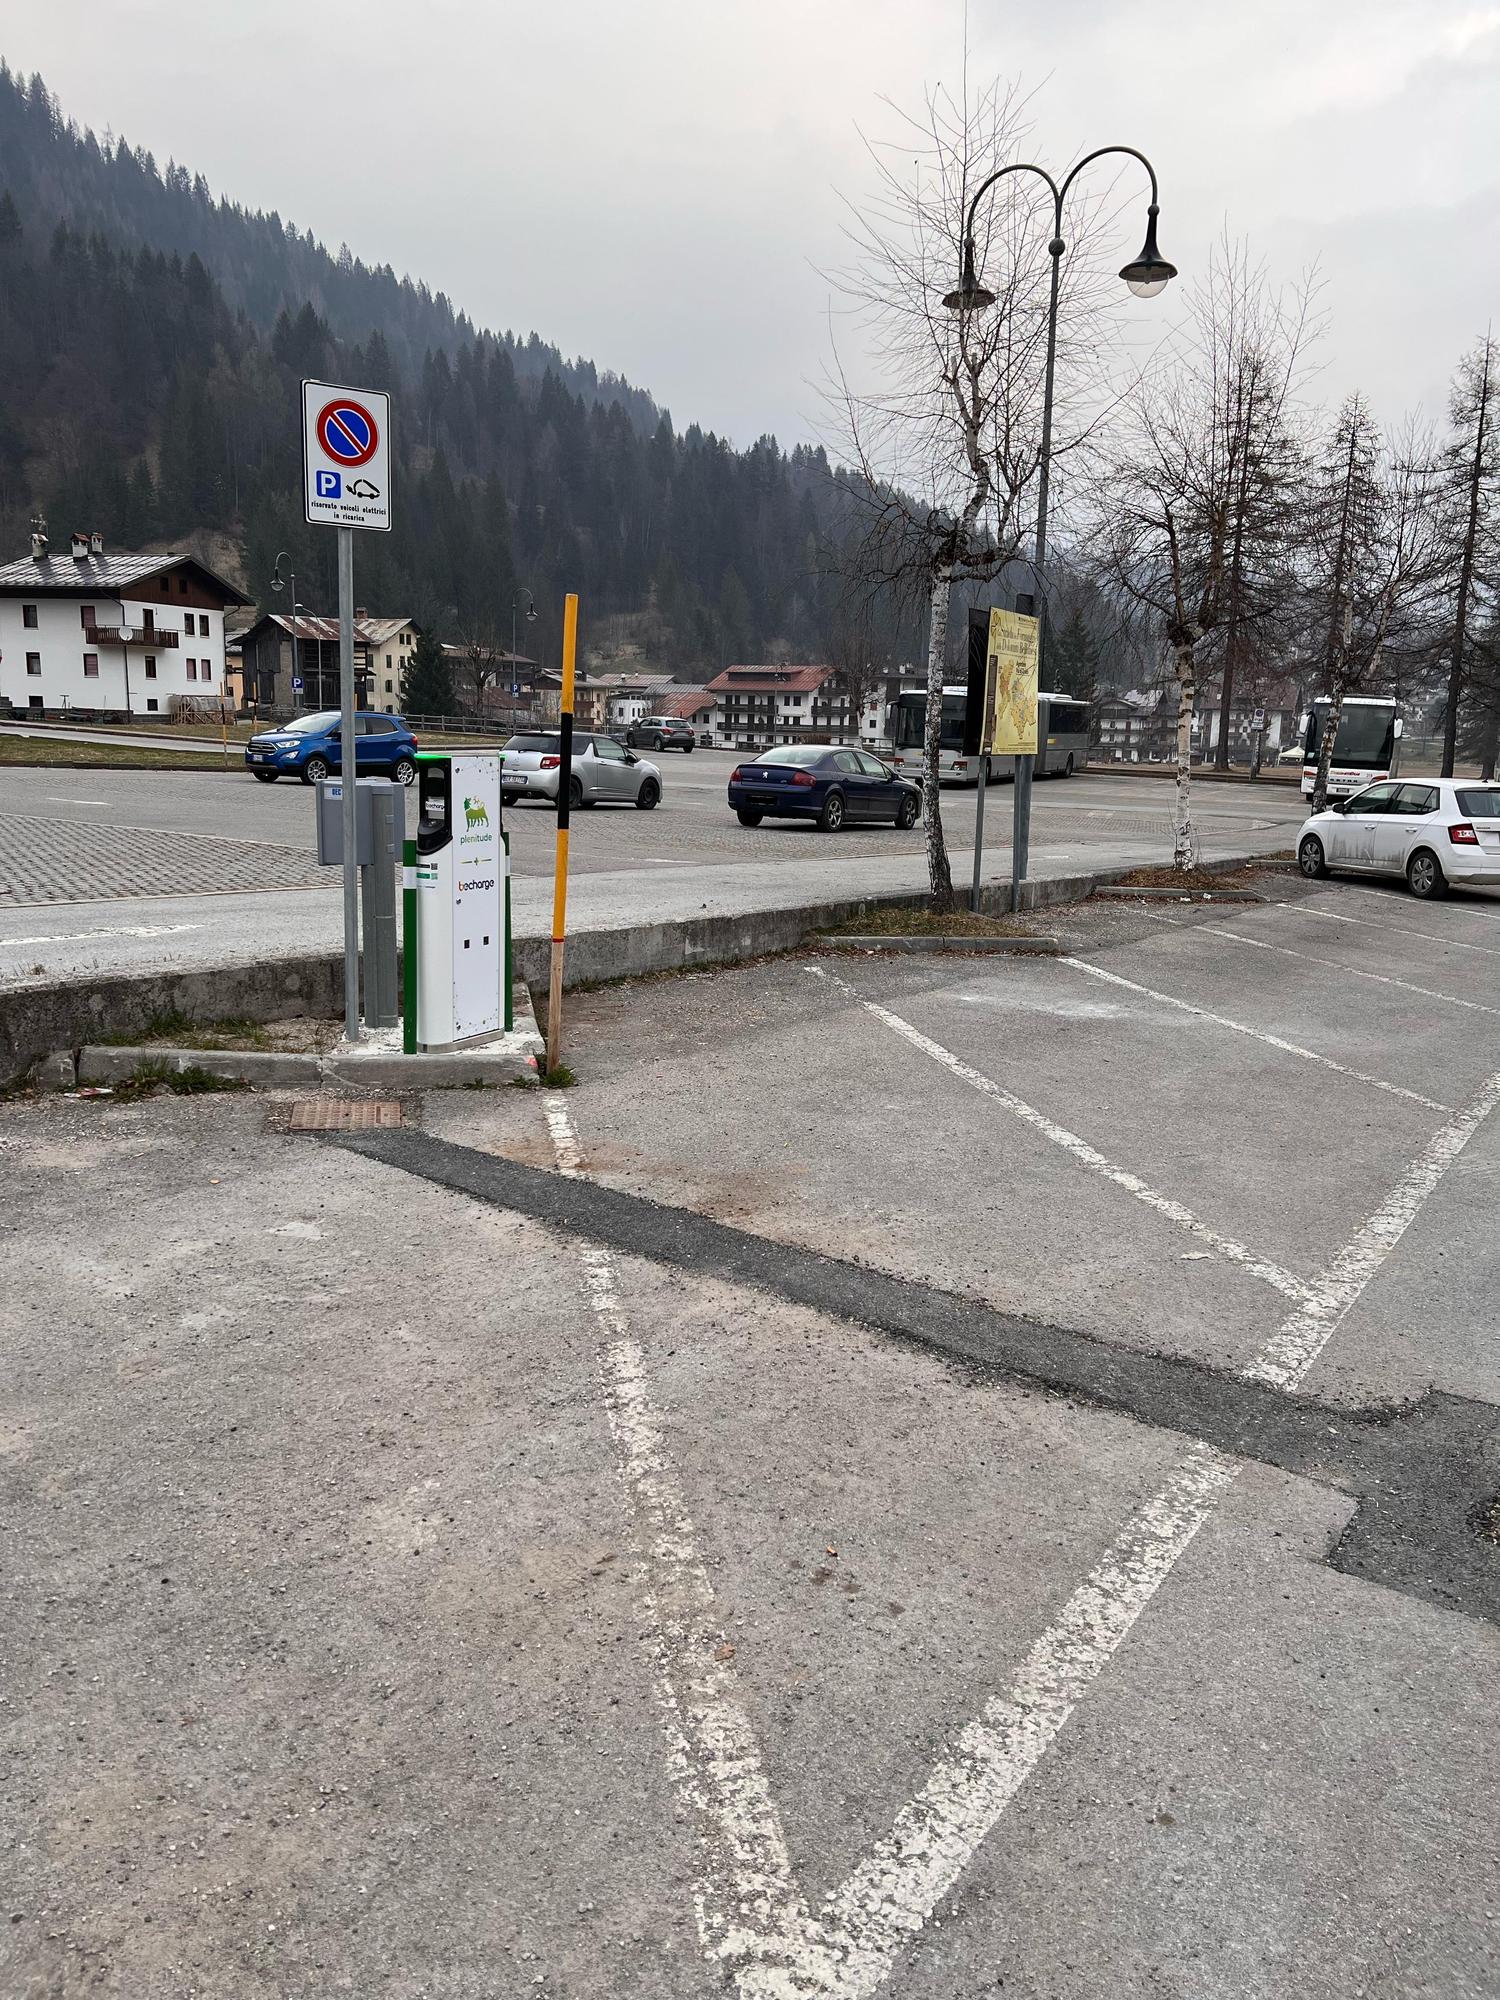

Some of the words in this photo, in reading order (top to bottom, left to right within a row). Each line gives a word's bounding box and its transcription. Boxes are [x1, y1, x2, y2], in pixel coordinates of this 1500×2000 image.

[321, 473, 336, 495] P
[311, 500, 337, 510] riservato
[340, 504, 359, 513] veicoli
[362, 506, 387, 515] elettrici
[333, 511, 340, 519] in
[343, 513, 365, 522] ricarica
[460, 833, 493, 846] plenitude
[458, 878, 495, 892] becharge
